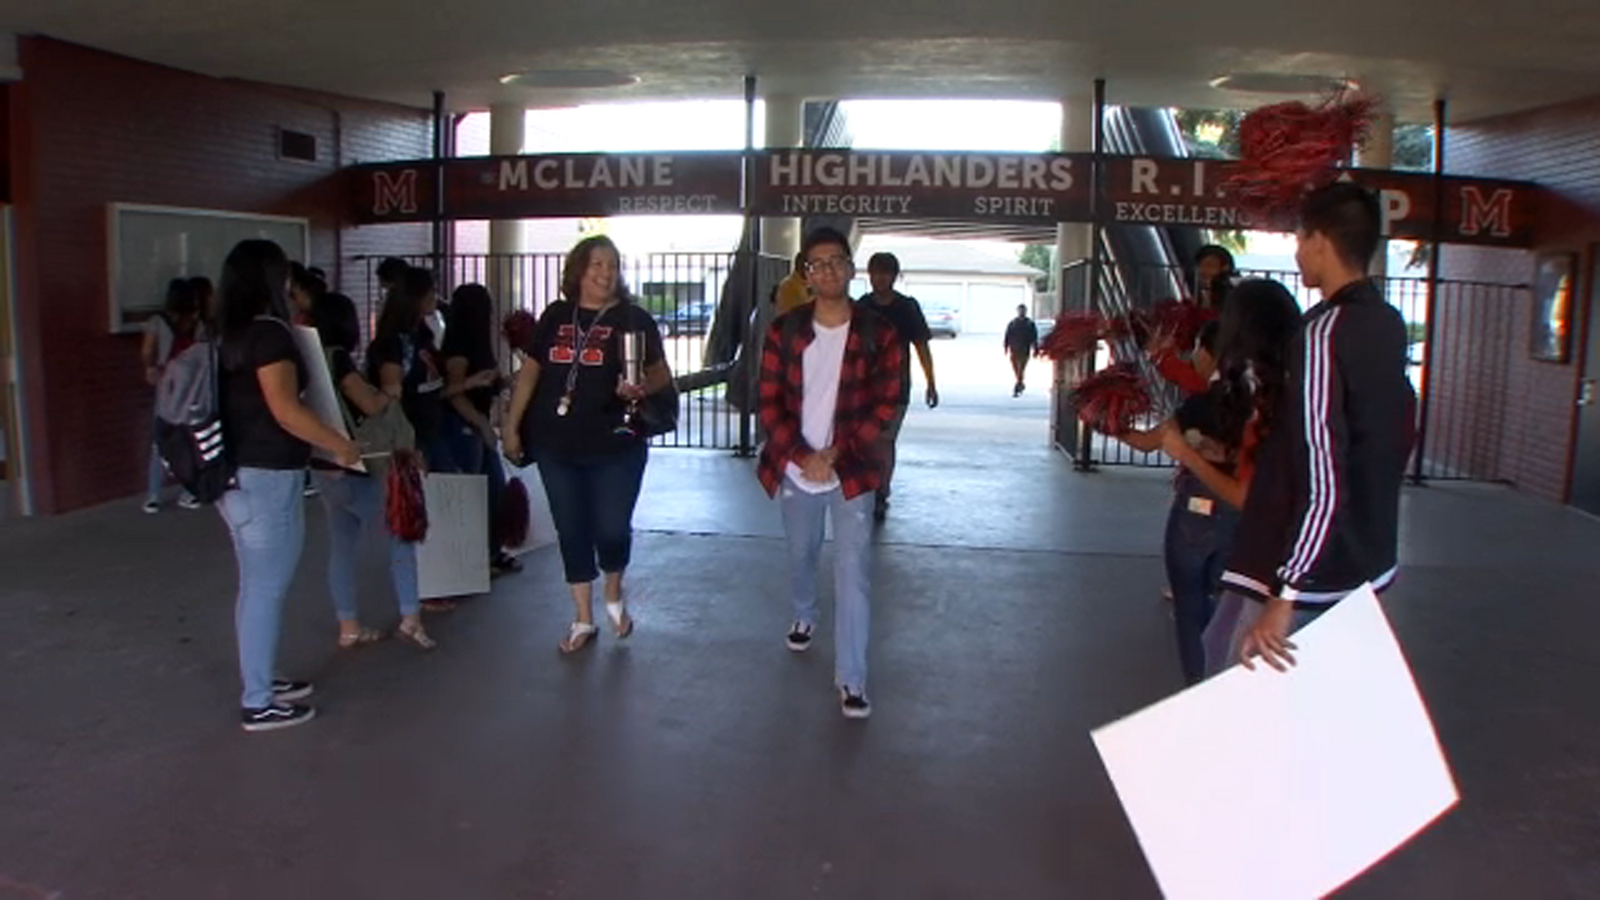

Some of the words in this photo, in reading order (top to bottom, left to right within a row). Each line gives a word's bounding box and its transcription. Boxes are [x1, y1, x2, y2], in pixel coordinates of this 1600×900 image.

[373, 169, 418, 216] M
[498, 156, 675, 191] MCLANE
[770, 153, 1074, 191] HIGHLANDERS
[1131, 158, 1226, 198] R.I.
[618, 194, 717, 214] RESPECT
[782, 194, 912, 214] INTEGRITY
[974, 195, 1055, 216] SPIRIT
[1115, 202, 1253, 226] EXCELLENC
[1461, 187, 1513, 237] M
